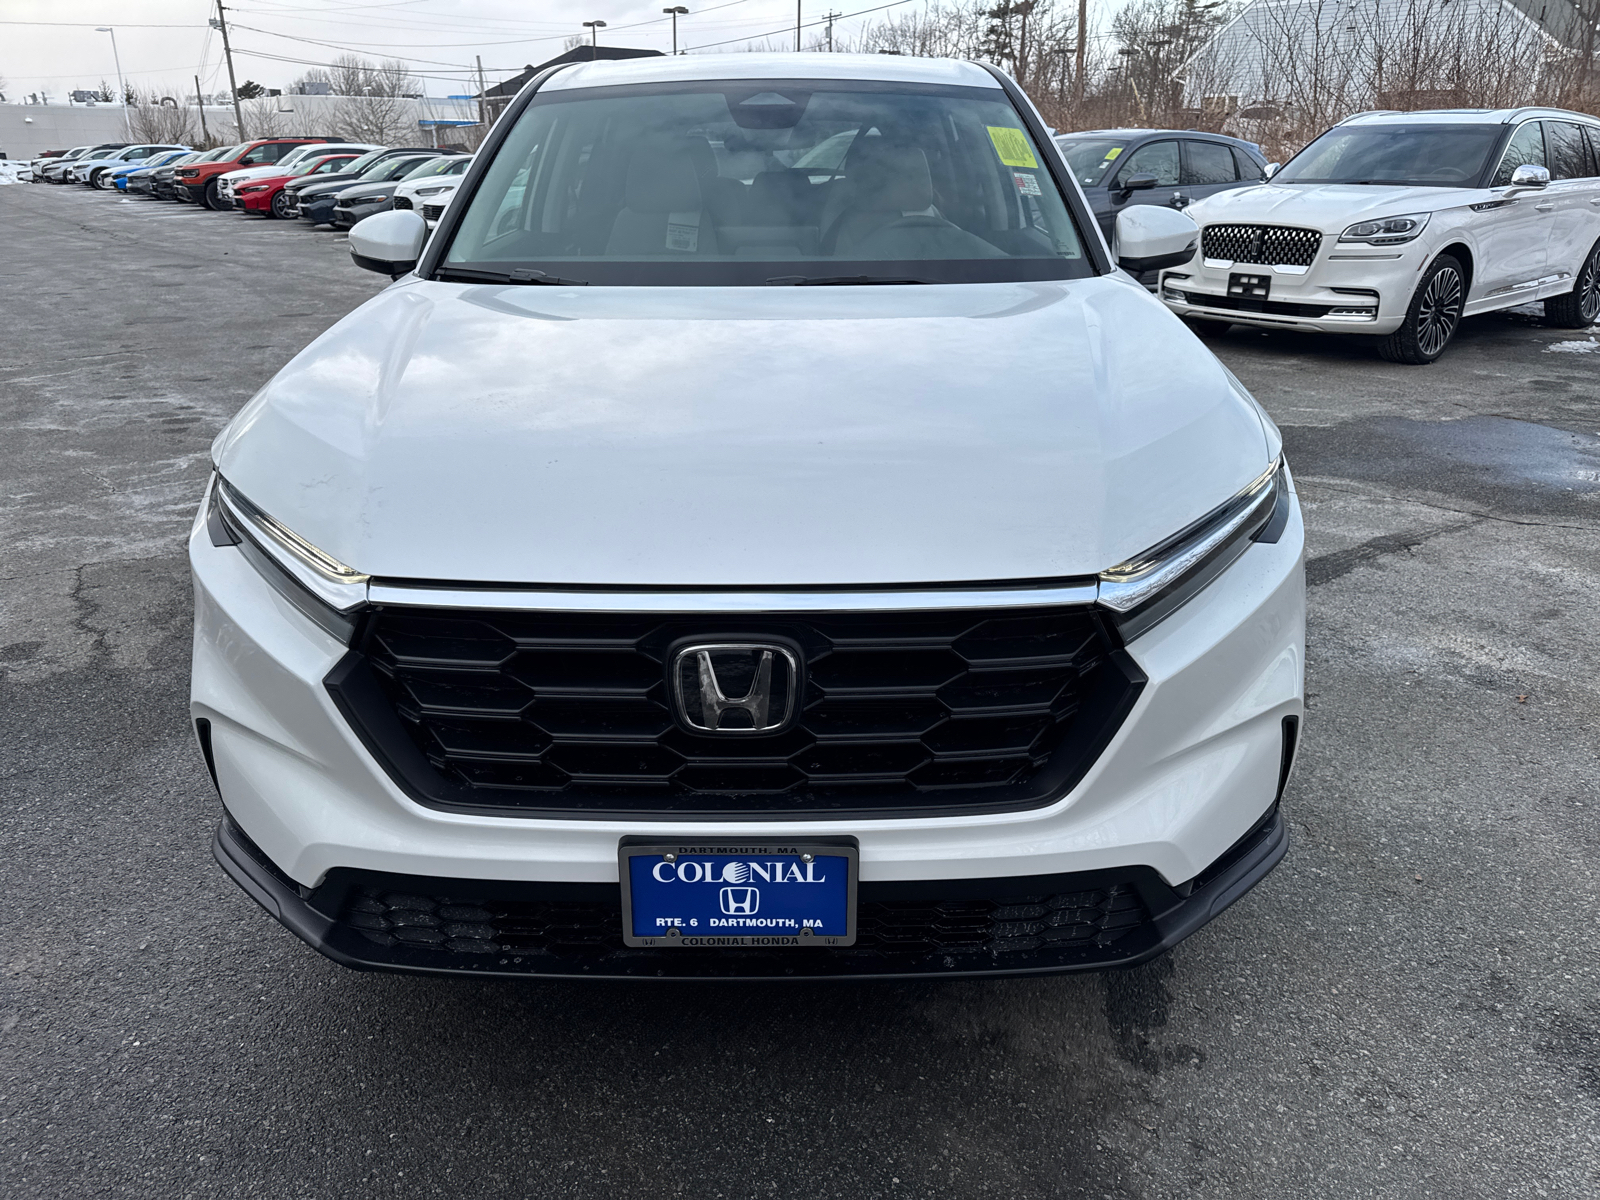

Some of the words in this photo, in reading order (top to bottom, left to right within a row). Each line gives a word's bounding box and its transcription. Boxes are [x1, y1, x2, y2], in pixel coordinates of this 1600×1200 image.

[678, 847, 772, 855] DARTMOUTH,
[652, 861, 826, 884] COLONIAL
[656, 917, 686, 927] RTE.
[689, 917, 698, 927] 6
[709, 918, 799, 929] DARTMOUTH,
[803, 919, 823, 928] MA
[681, 937, 748, 946] COLONIAL
[751, 937, 799, 945] HONDA
